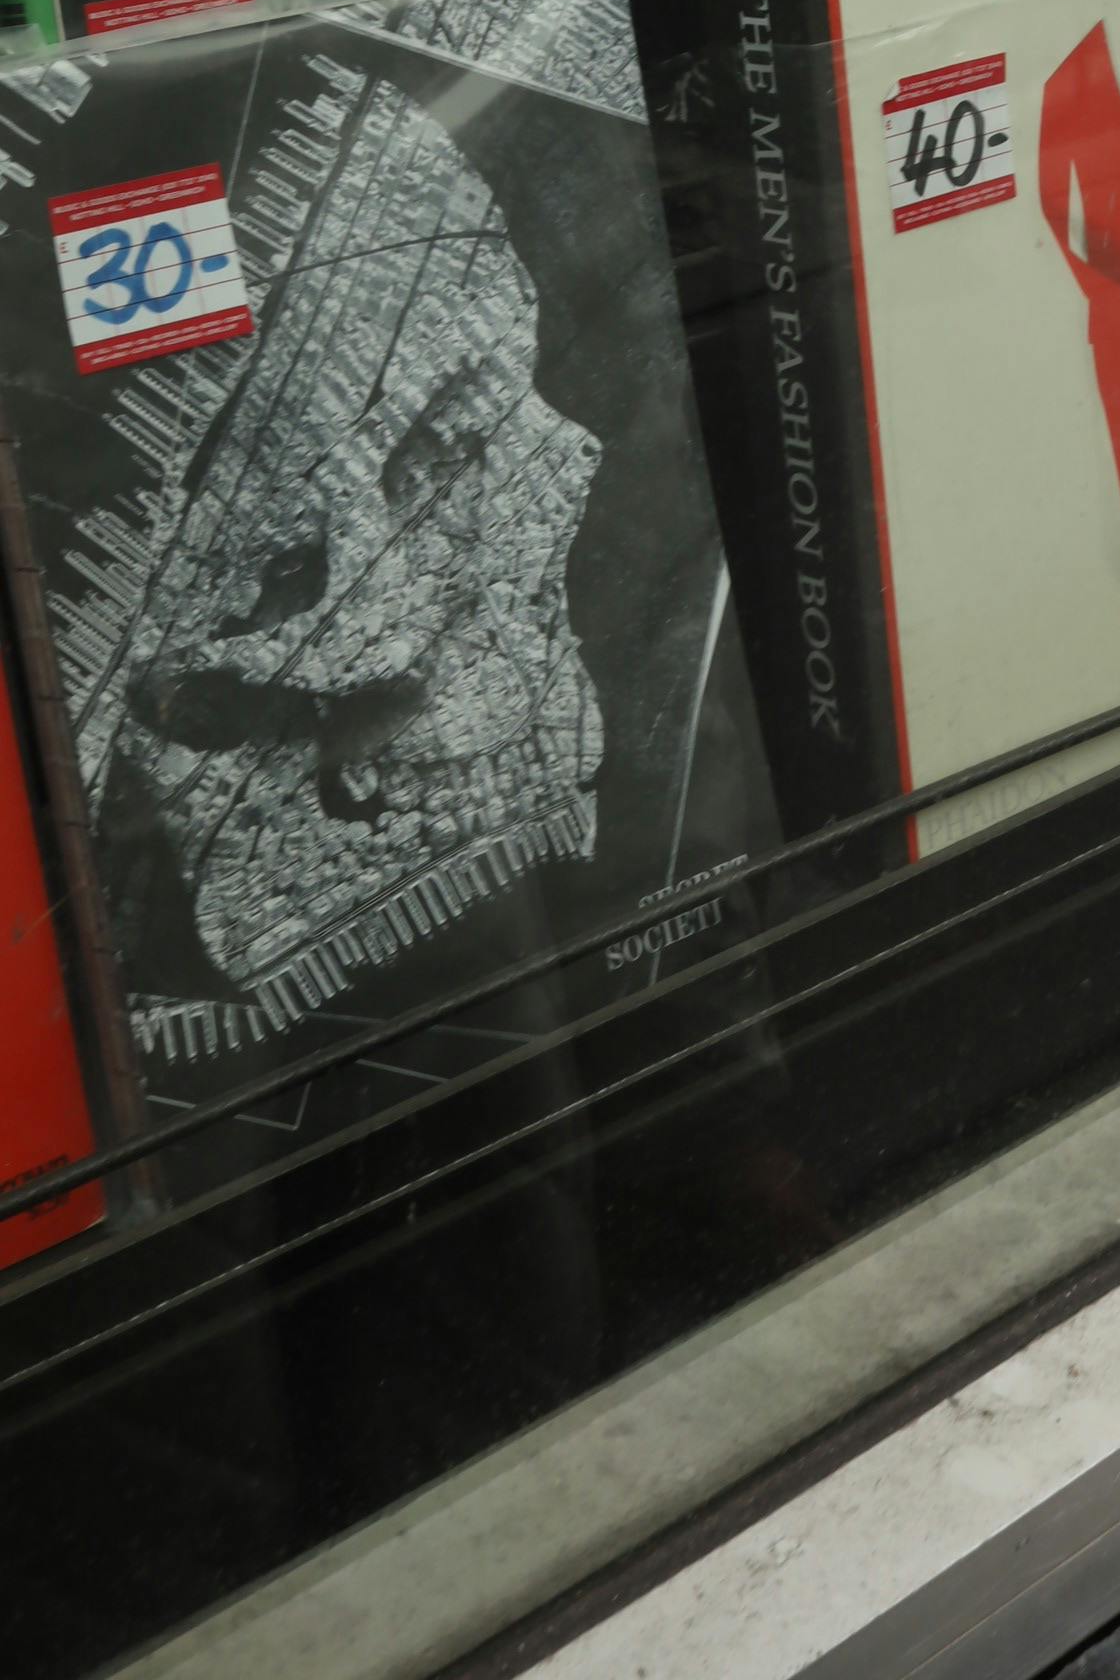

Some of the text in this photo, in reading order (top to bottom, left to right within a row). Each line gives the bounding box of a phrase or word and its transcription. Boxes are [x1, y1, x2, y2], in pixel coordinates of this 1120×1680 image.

[747, 101, 798, 294] MEN'S
[767, 306, 825, 562] FASHION
[798, 569, 841, 736] BOOK
